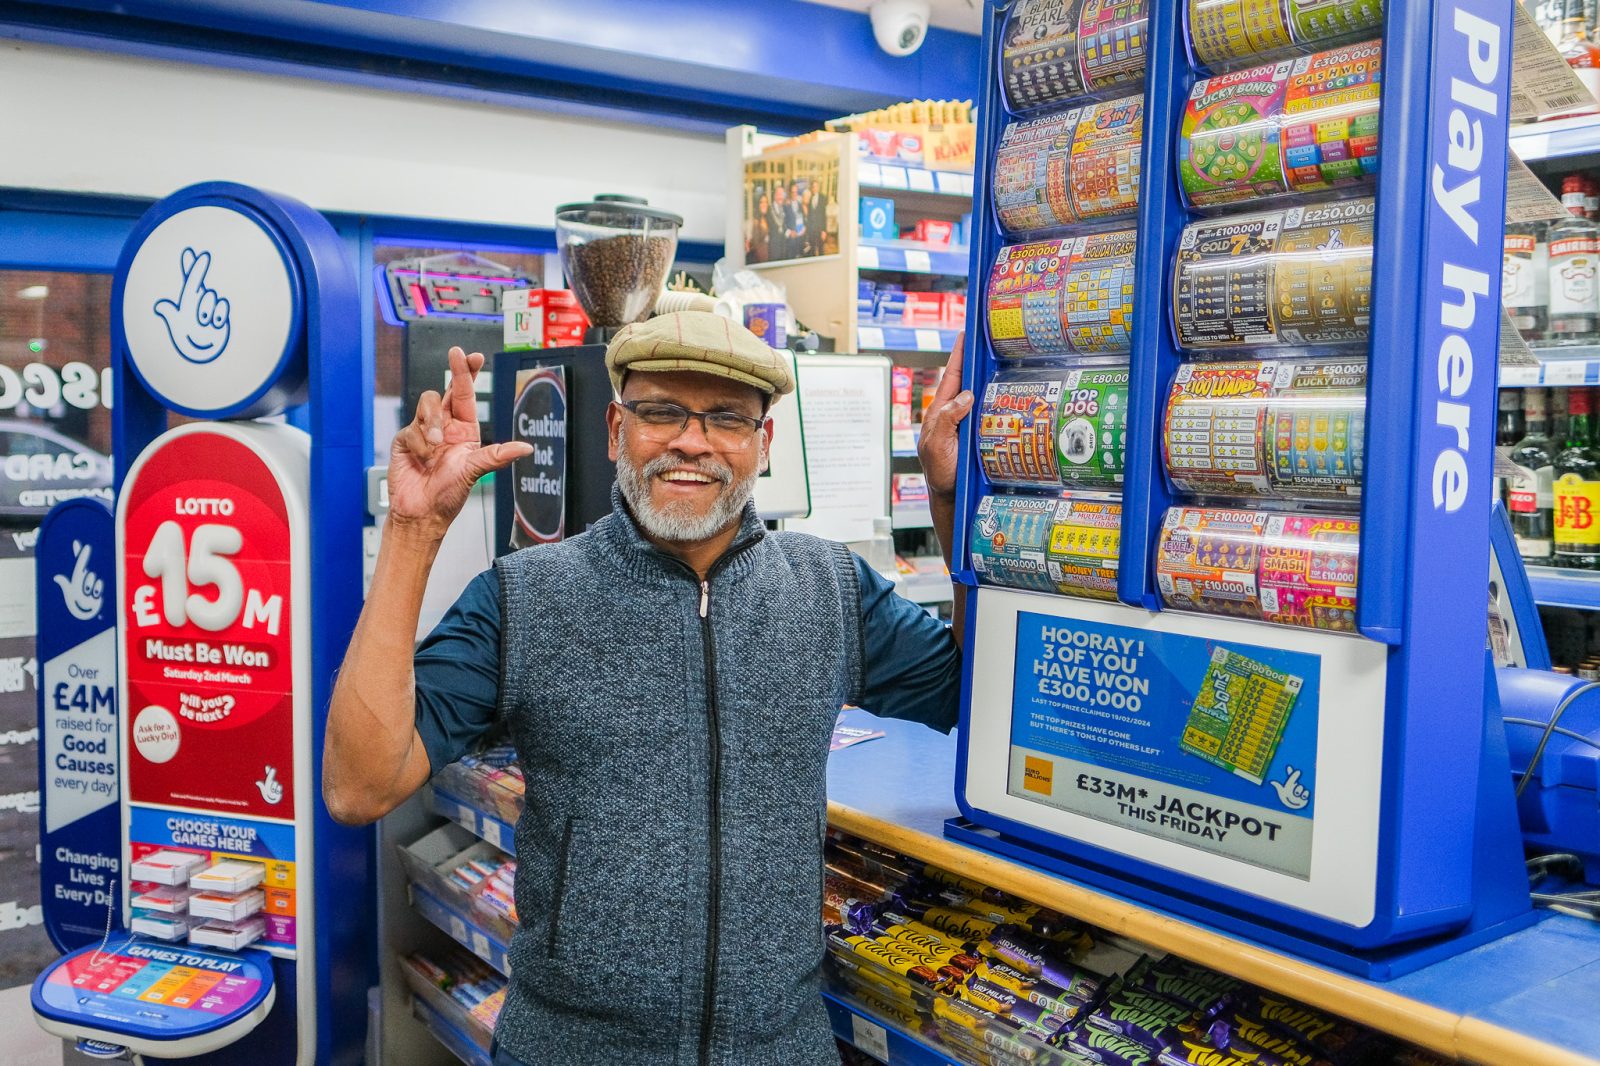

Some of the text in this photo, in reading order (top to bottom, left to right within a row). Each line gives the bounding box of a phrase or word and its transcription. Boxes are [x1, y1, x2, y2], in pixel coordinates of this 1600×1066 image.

[1022, 7, 1065, 31] PEARL
[1313, 47, 1380, 69] £300,000
[1221, 65, 1274, 84] £300,000
[1277, 65, 1289, 74] £3
[1309, 74, 1366, 92] BLOCKS
[1195, 82, 1277, 111] LUCKY BONUS
[1304, 202, 1375, 222] £250,000
[1216, 223, 1262, 236] £100,000
[1266, 223, 1278, 231] £2
[1200, 240, 1231, 252] GOLD
[1432, 7, 1501, 513] Play here
[1304, 331, 1369, 341] £250,00
[1262, 366, 1274, 375] £2
[1211, 377, 1257, 397] LOADED
[1297, 376, 1361, 387] LUCKY DROP
[1049, 387, 1059, 395] £2
[1070, 388, 1099, 402] TOP
[991, 393, 1036, 411] JOLLY
[1063, 400, 1099, 417] DOG
[518, 412, 564, 438] Caution
[534, 443, 554, 466] hot
[175, 497, 234, 516] LOTTO
[1074, 502, 1122, 515] MONEY TRE
[1555, 495, 1593, 529] J&B
[1163, 541, 1195, 553] JEWELS
[1064, 564, 1116, 578] MONEY TREE
[1264, 558, 1305, 571] SMASH
[1204, 580, 1243, 593] £10,000
[146, 639, 269, 667] Must Be Won
[1042, 643, 1137, 674] 3 OF YOU
[68, 664, 98, 680] Over
[164, 667, 252, 684] Saturday 2nd March
[1033, 659, 1149, 696] HAVE WON
[53, 682, 115, 715] £4M
[1038, 677, 1142, 712] £300,000
[180, 704, 194, 720] be
[1031, 697, 1047, 705] LAST
[1049, 700, 1061, 708] TOP
[1062, 703, 1080, 712] PRIZE
[1080, 706, 1111, 718] CLAIMED
[56, 717, 113, 733] raised for
[138, 723, 152, 733] Ask
[153, 723, 165, 733] for
[1030, 712, 1131, 740] THE TOP PRIZES HAVE GONE
[63, 734, 106, 754] Good
[137, 731, 177, 743] Lucky Dip!
[1030, 720, 1044, 729] BUT
[1045, 723, 1075, 736] THERE'S
[1076, 731, 1096, 741] TONS
[1097, 735, 1108, 744] OF
[1108, 738, 1140, 751] OTHERS
[55, 754, 114, 775] Causes
[1025, 767, 1040, 775] EURO
[55, 778, 88, 794] every
[1024, 772, 1051, 783] MILLIONS
[1117, 801, 1228, 842] THIS FRIDAY
[1153, 794, 1282, 842] JACKPOT
[166, 818, 256, 840] CHOOSE YOUR
[171, 831, 252, 852] GAMES HERE
[56, 847, 118, 872] Changing
[70, 868, 104, 886] Lives
[55, 884, 115, 909] Every Da
[128, 946, 241, 972] GAMES TO PLAY
[1013, 945, 1033, 960] MILK
[987, 988, 1005, 1001] MILK
